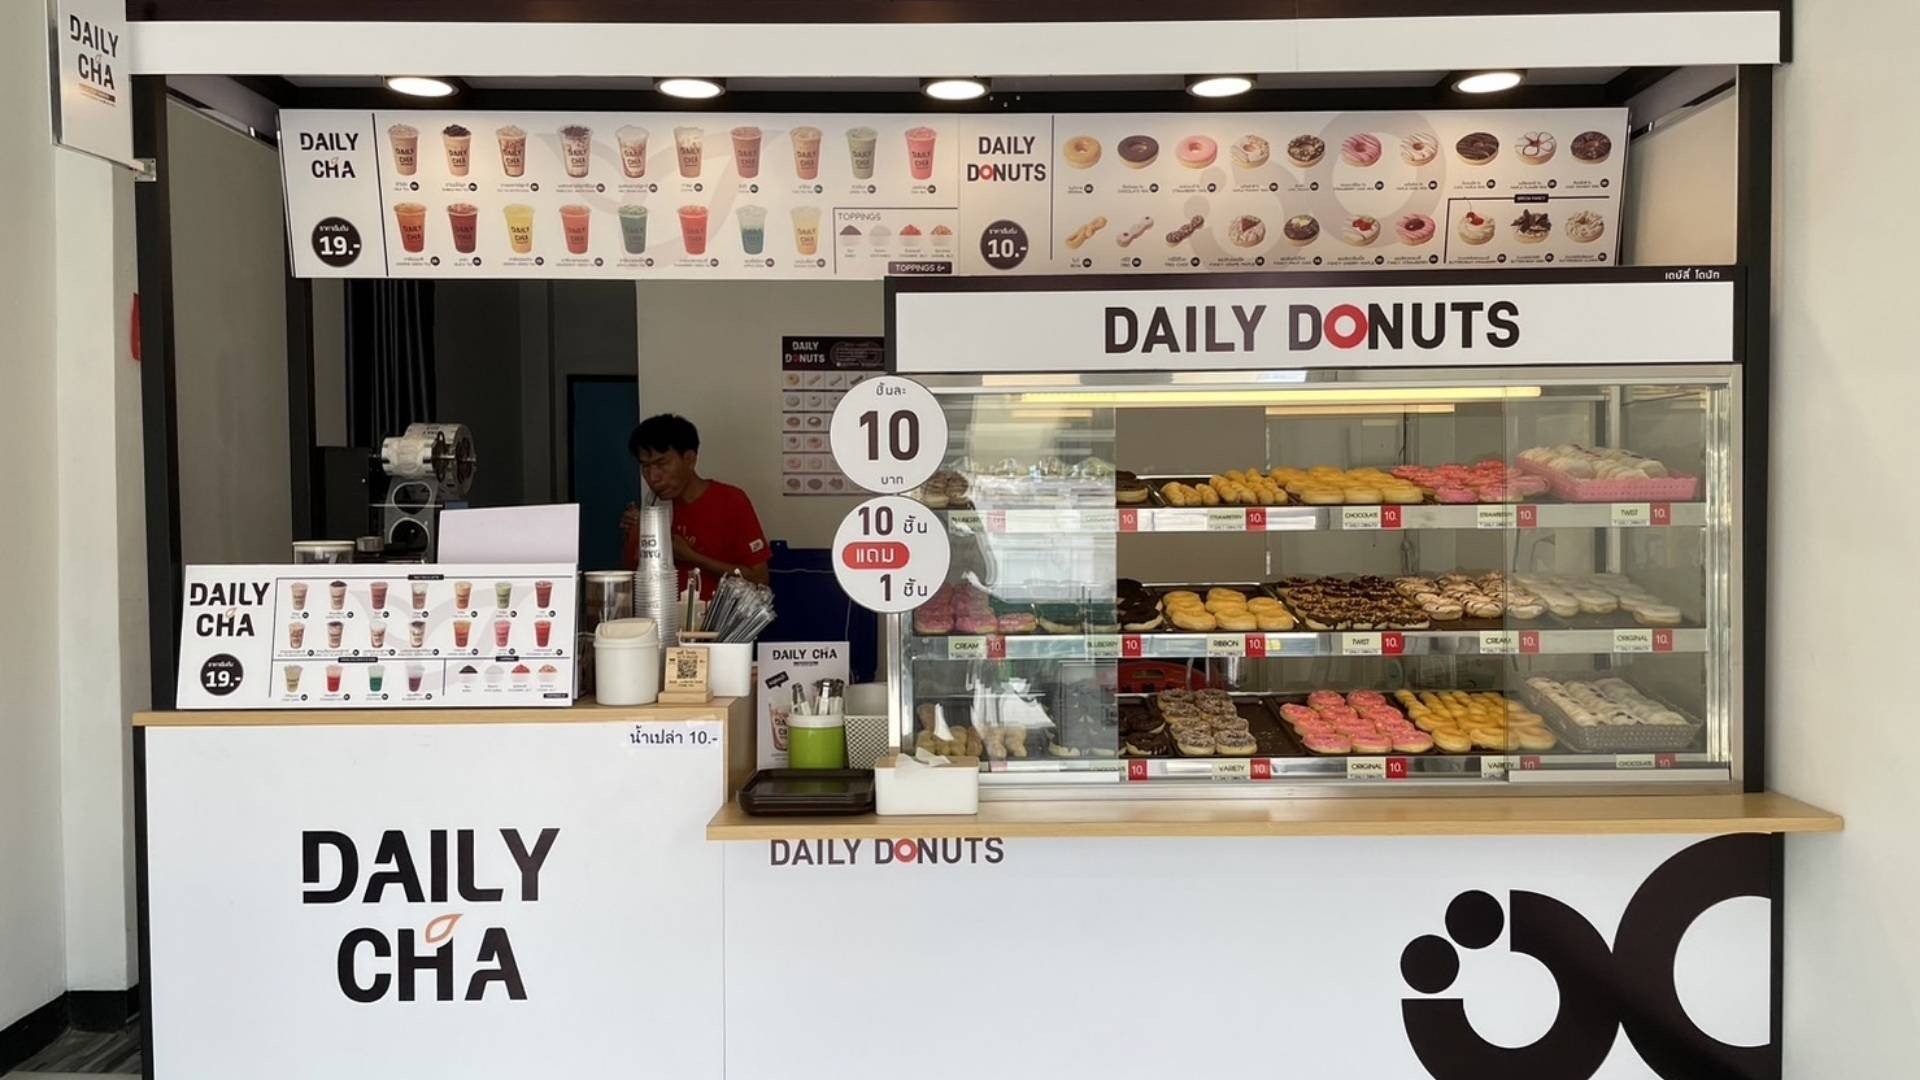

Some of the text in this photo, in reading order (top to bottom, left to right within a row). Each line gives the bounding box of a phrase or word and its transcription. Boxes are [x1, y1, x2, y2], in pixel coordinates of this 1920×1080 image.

[69, 14, 119, 58] DAILY
[78, 53, 115, 90] CHA
[300, 132, 359, 151] DAILY
[978, 136, 1036, 155] DAILY
[311, 160, 356, 179] CHA
[967, 163, 1047, 182] DONUTS
[838, 212, 881, 221] TOPPINGS
[319, 235, 361, 256] 19.-
[987, 239, 1027, 258] 10.-
[895, 264, 935, 272] TOPPINGS
[1105, 300, 1520, 354] DAILY DONUTS
[792, 341, 820, 351] DAILY
[785, 353, 825, 364] DONUTS
[859, 409, 920, 461] 10
[881, 475, 904, 485] บาท
[858, 505, 928, 536] 10 ชิ้น
[856, 548, 894, 563] แถม
[190, 582, 271, 606] DAILY
[880, 573, 928, 602] 1 ชิ้น
[196, 612, 255, 637] CHA
[772, 648, 838, 660] DAILY CHA
[954, 642, 979, 650] CREAM
[205, 670, 241, 688] 19.-
[629, 724, 718, 745] น้ำเปล่า 10.-
[770, 837, 1005, 866] DAILY DONUTS
[301, 827, 561, 904] DAILY
[337, 926, 529, 1004] CHA
